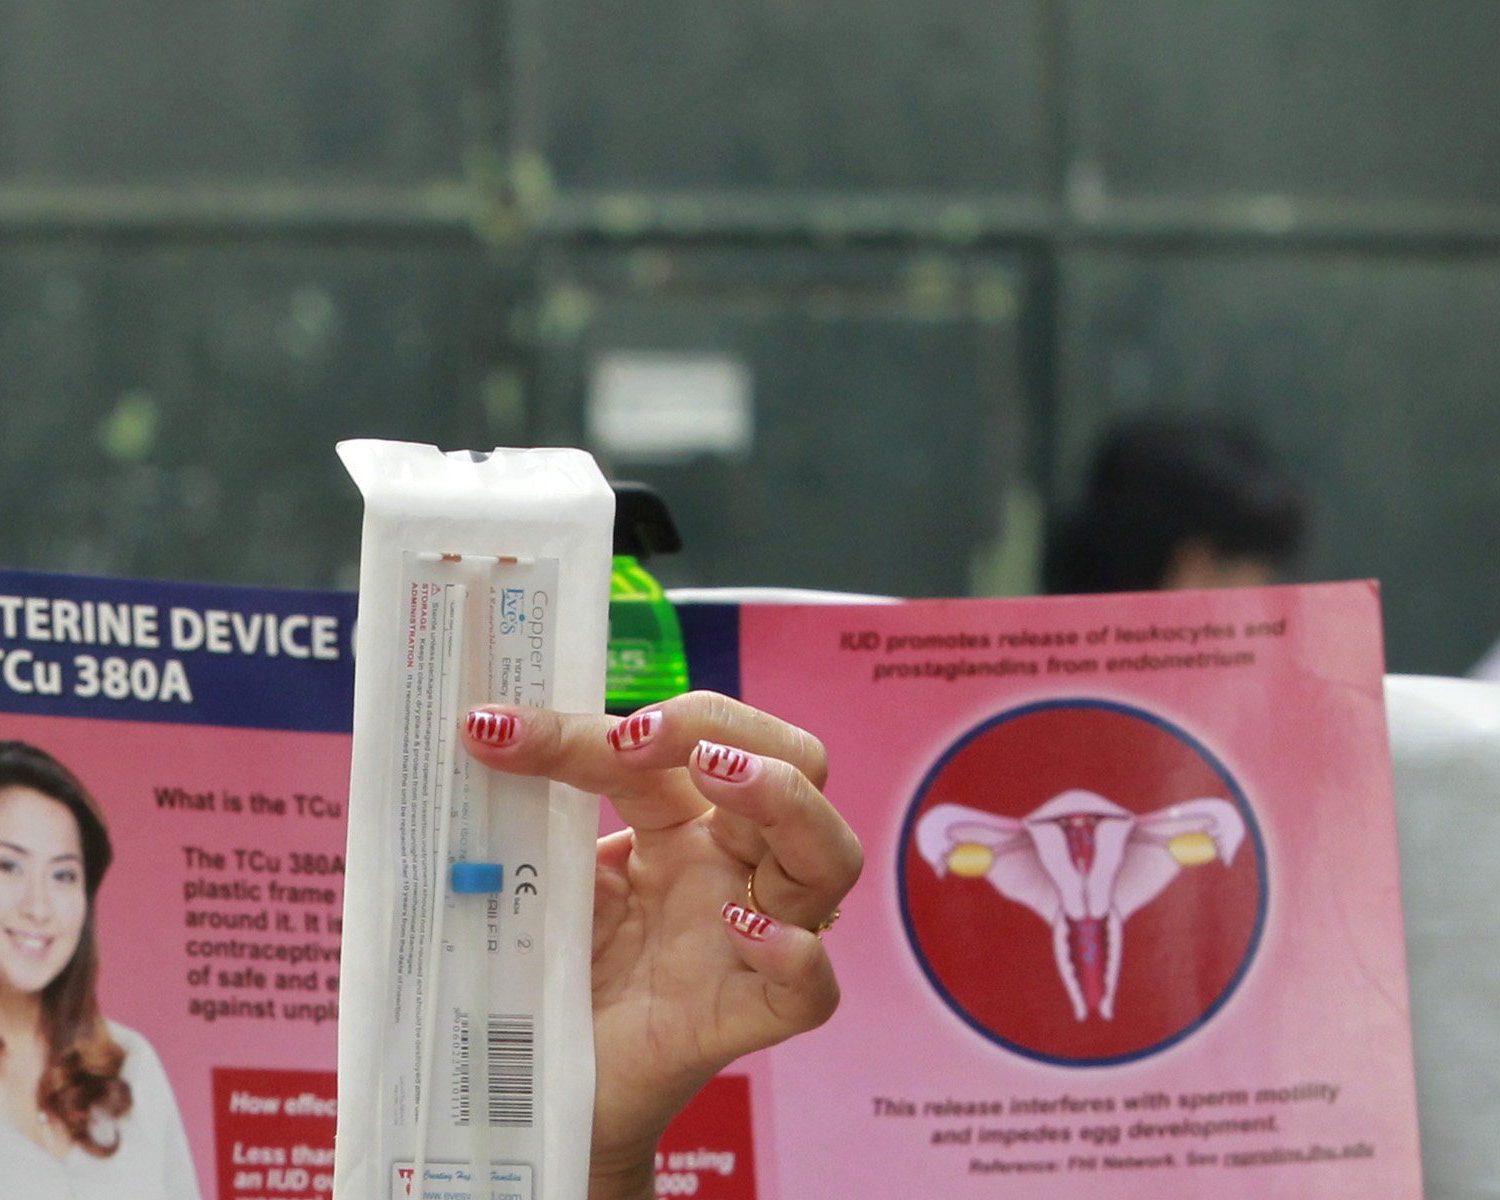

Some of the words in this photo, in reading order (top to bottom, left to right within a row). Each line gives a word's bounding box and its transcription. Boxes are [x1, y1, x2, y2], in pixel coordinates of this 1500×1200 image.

[420, 583, 429, 630] STORAGE
[430, 602, 439, 630] Sterile
[500, 588, 524, 635] Eve's
[171, 608, 339, 659] DEVICE
[406, 583, 418, 667] ADMINISTRATION
[527, 590, 548, 672] Copper
[839, 631, 881, 651] IUD
[885, 632, 990, 655] promotes
[997, 631, 1078, 649] release
[1086, 629, 1109, 645] of
[1113, 621, 1236, 646] leukocytes
[1244, 618, 1287, 638] and
[417, 638, 427, 660] Keep
[74, 657, 193, 702] 380A
[426, 662, 436, 700] package
[500, 657, 512, 697] Efficacy
[514, 658, 524, 683] Intra
[872, 656, 1039, 683] prostaglandins
[1046, 655, 1097, 674] from
[1106, 650, 1255, 672] endometrium
[530, 679, 545, 691] T
[414, 700, 422, 713] dry
[402, 690, 411, 754] recommended
[414, 714, 422, 738] place
[424, 710, 433, 751] damaged
[153, 786, 216, 811] What
[222, 789, 243, 812] is
[250, 792, 286, 815] the
[293, 794, 341, 818] TCu
[411, 781, 419, 800] from
[400, 806, 407, 818] be
[399, 819, 407, 857] replaced
[410, 828, 418, 863] sunlight
[182, 846, 226, 870] The
[234, 849, 281, 873] TCu
[289, 853, 345, 876] 380A
[184, 880, 261, 901] plastic
[269, 881, 335, 905] frame
[403, 881, 409, 891] 10
[515, 864, 538, 896] CE
[401, 892, 409, 916] years
[185, 909, 268, 931] around
[304, 912, 320, 933] It
[419, 935, 426, 946] be
[416, 947, 425, 977] reused
[187, 964, 210, 986] of
[218, 966, 267, 989] safe
[275, 970, 318, 991] and
[189, 998, 275, 1022] against
[415, 1027, 422, 1039] be
[414, 1039, 422, 1084] destroyed
[229, 1090, 281, 1116] How
[872, 1098, 916, 1118] This
[924, 1099, 1003, 1118] release
[1009, 1096, 1116, 1116] interferes
[1124, 1092, 1171, 1112] with
[1178, 1090, 1249, 1112] sperm
[1255, 1084, 1340, 1105] motility
[930, 1126, 971, 1146] and
[978, 1125, 1071, 1147] impedes
[1080, 1125, 1120, 1147] egg
[1128, 1115, 1280, 1142] development.
[232, 1141, 286, 1166] Less
[668, 1148, 736, 1176] using
[233, 1170, 264, 1191] an
[266, 1168, 310, 1192] IUD
